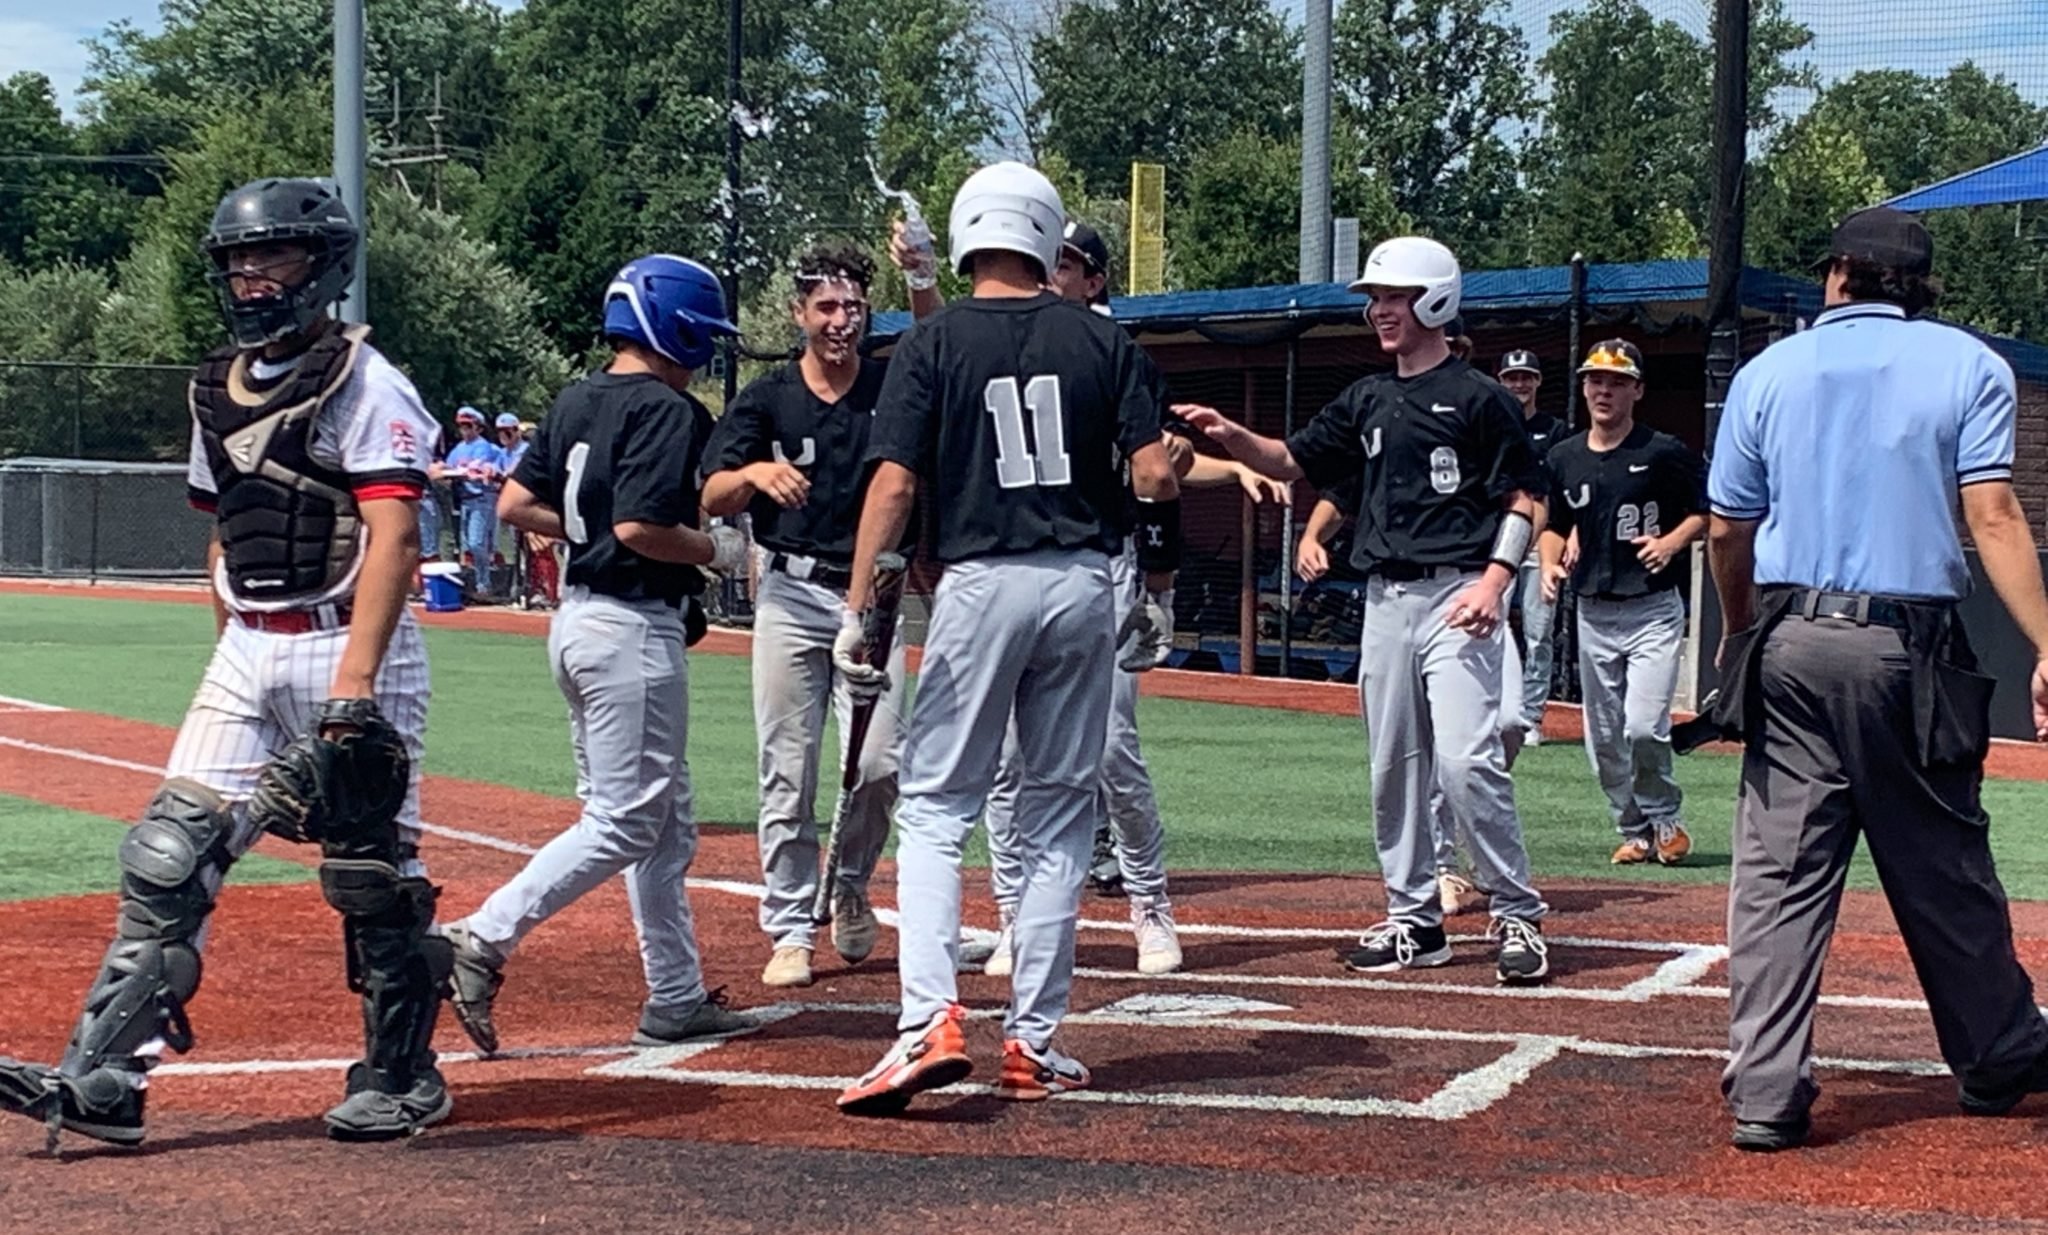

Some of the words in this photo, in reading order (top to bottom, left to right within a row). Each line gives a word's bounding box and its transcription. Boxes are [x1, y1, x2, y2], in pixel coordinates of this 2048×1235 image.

[1508, 352, 1527, 367] U
[984, 374, 1071, 488] 11
[563, 440, 590, 544] 1
[1430, 446, 1461, 494] 8
[1616, 501, 1661, 541] 22
